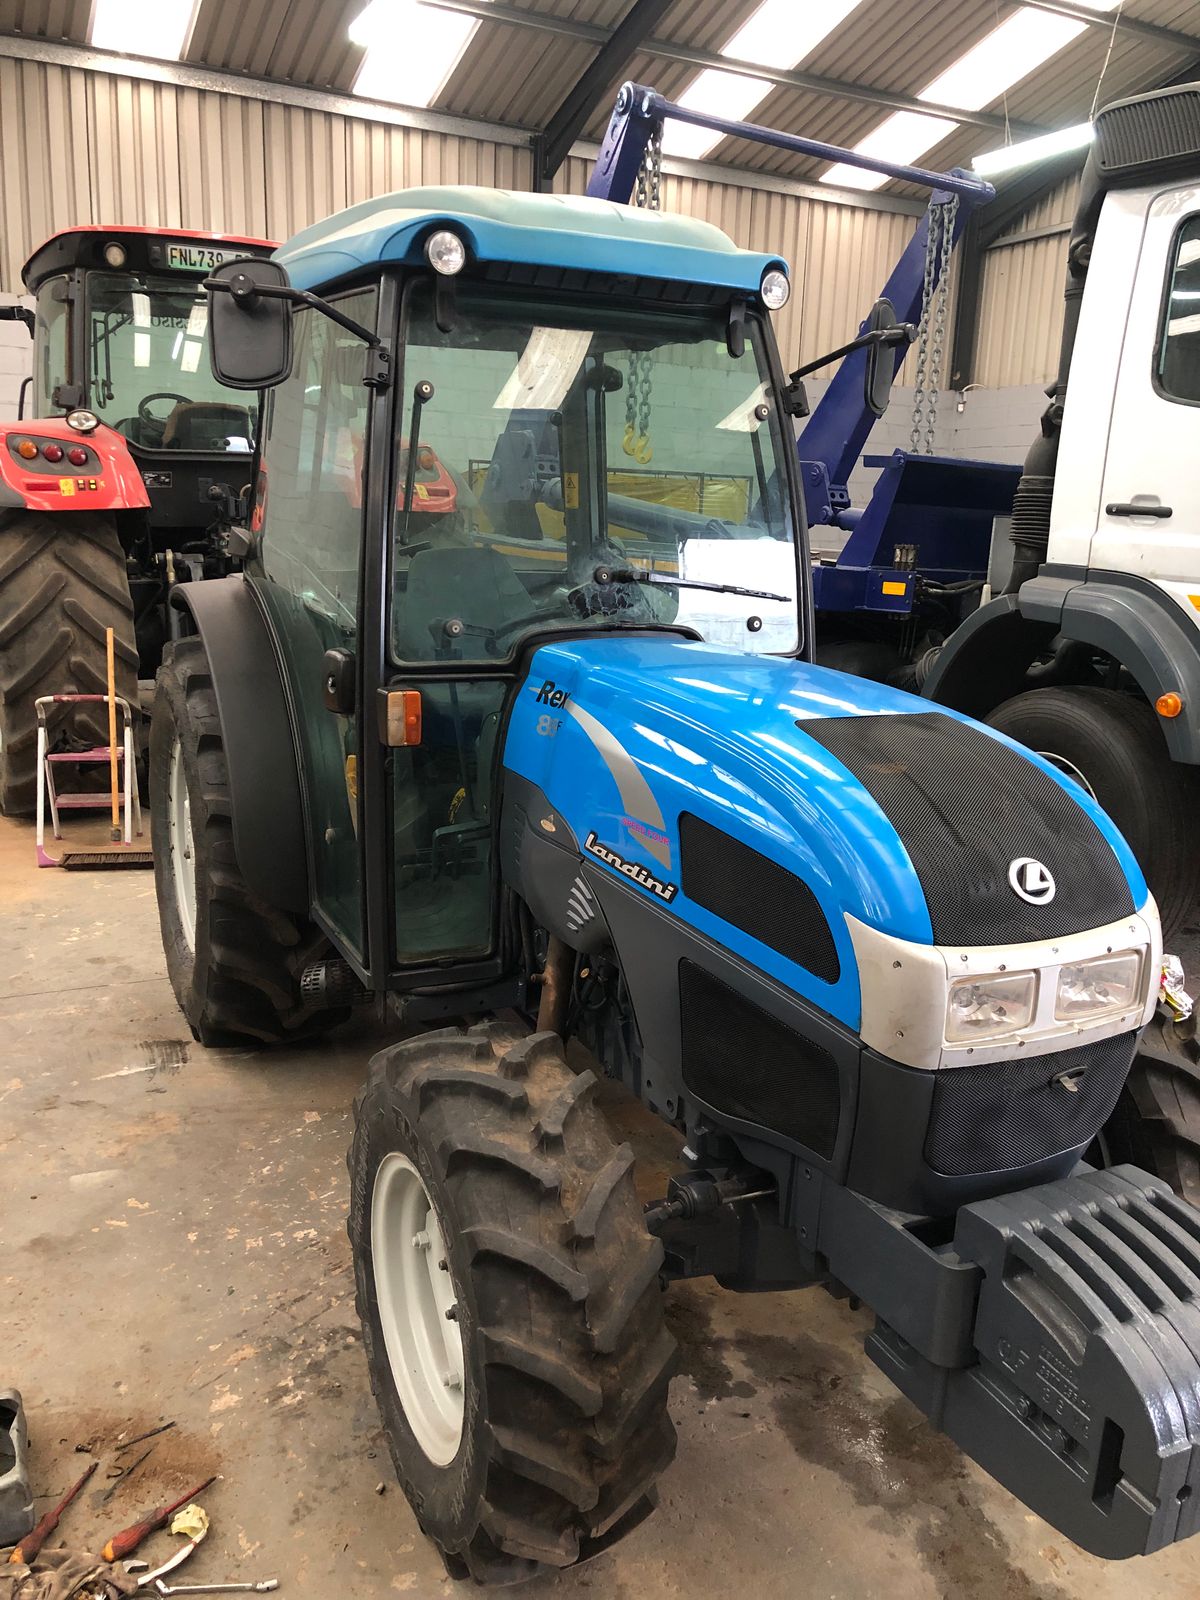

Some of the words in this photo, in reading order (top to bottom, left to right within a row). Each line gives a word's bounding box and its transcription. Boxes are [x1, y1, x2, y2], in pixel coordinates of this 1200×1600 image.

[170, 248, 223, 268] FNL739
[535, 680, 571, 709] Rex
[584, 832, 675, 900] Landini
